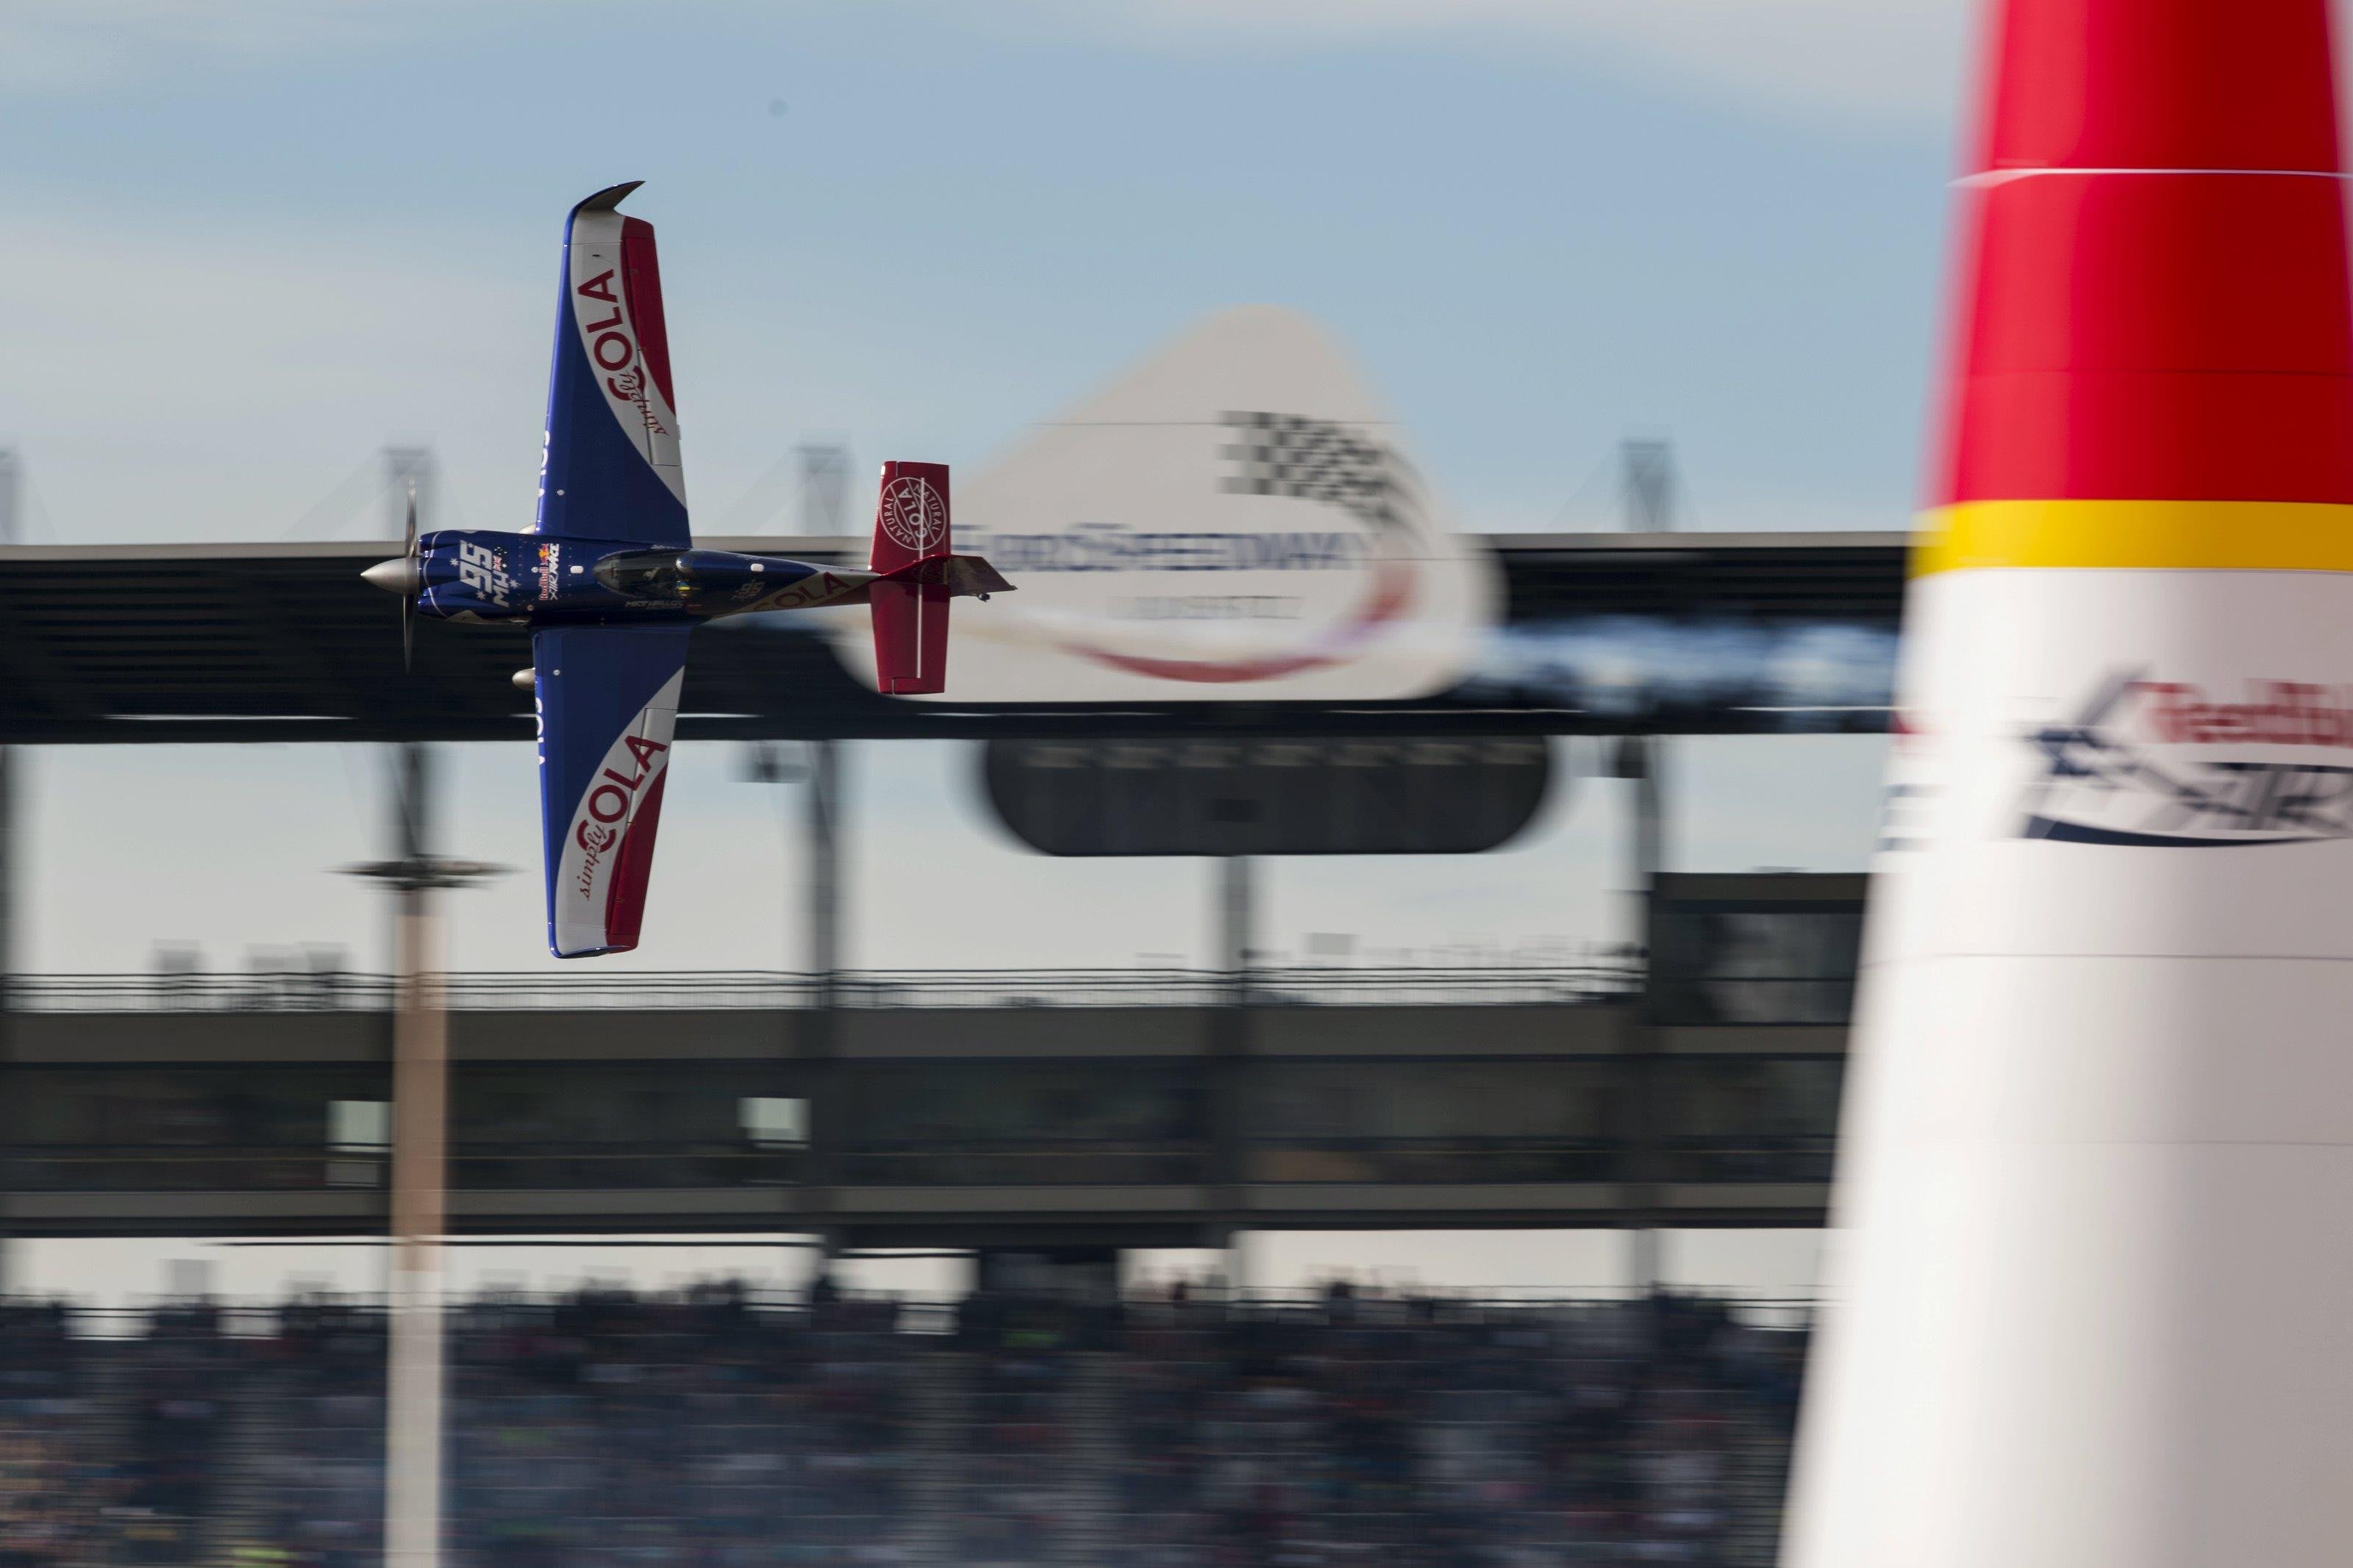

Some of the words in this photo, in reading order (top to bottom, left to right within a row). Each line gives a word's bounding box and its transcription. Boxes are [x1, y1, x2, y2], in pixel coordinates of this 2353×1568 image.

[577, 269, 646, 401] COLA
[884, 498, 912, 543] NATURAL
[898, 487, 928, 538] COLA
[460, 540, 492, 593] 95
[576, 735, 669, 853] COLA
[576, 825, 607, 901] simply
